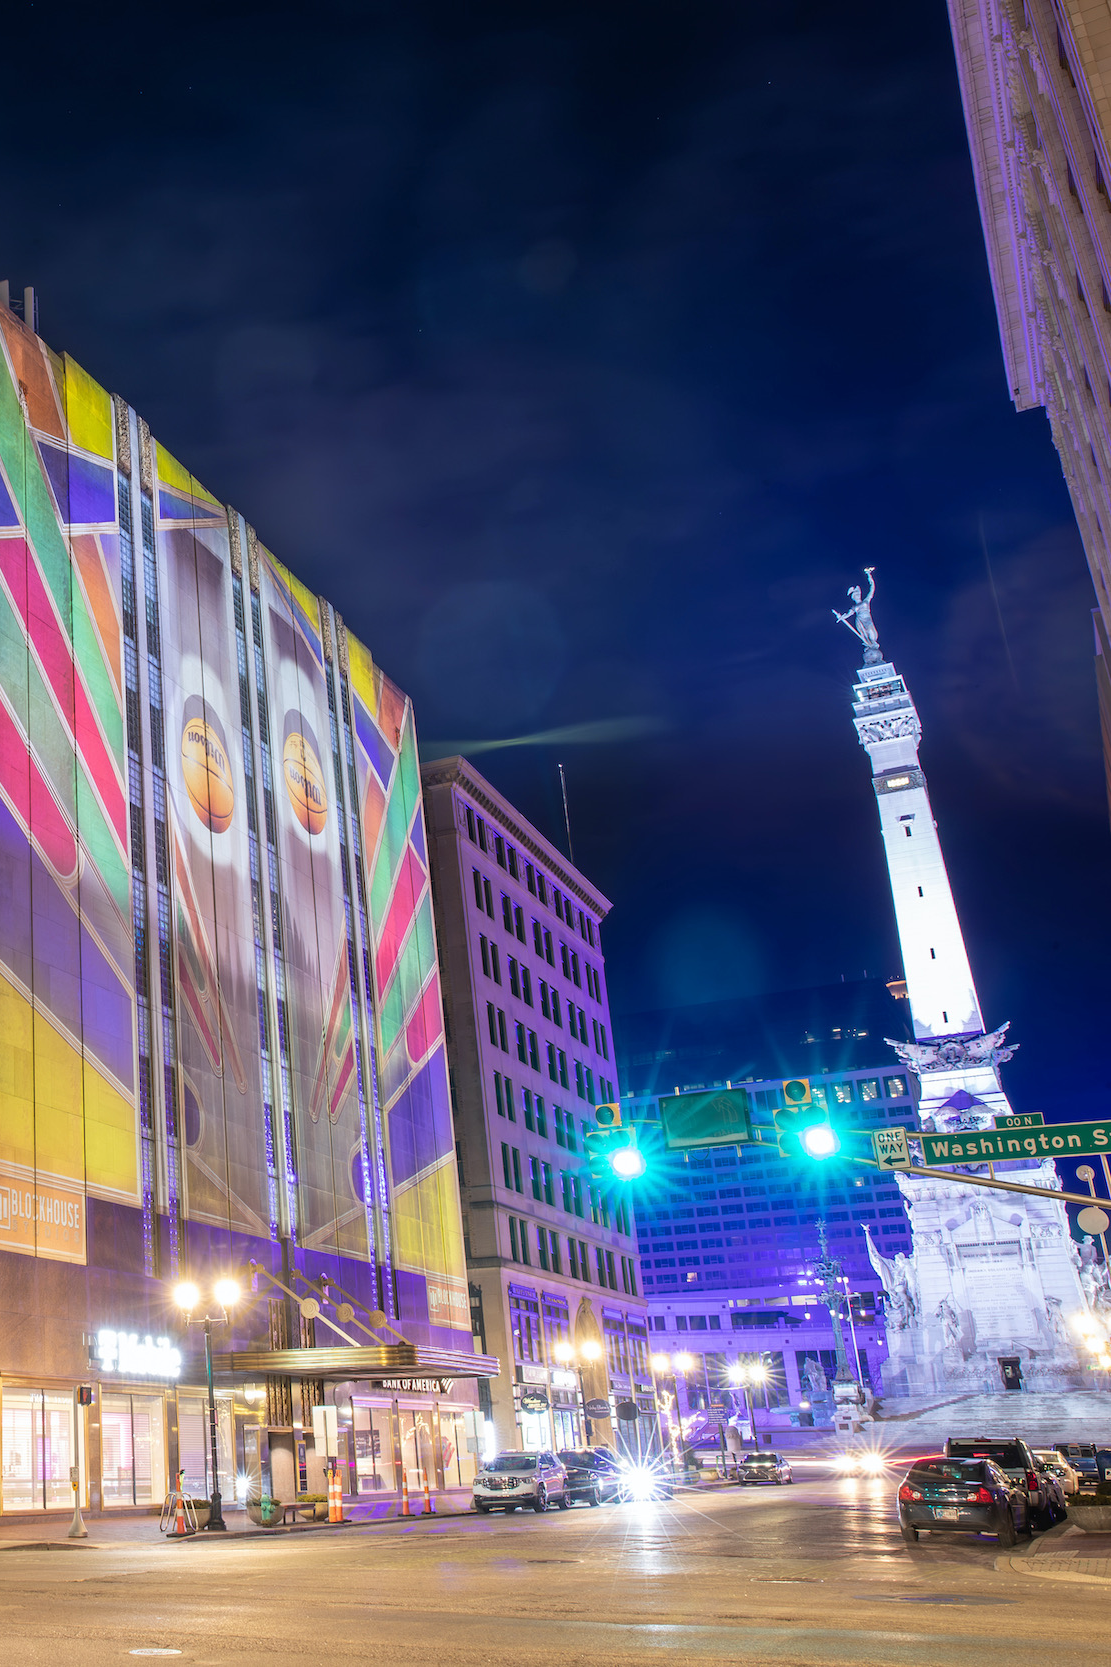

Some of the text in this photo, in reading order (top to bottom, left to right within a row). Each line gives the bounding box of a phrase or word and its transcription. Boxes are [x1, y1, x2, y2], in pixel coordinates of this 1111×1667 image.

[1006, 1116, 1033, 1127] 00 N
[877, 1131, 902, 1143] ONE
[931, 1128, 1111, 1156] Washington S
[879, 1143, 904, 1155] WAY
[11, 1189, 80, 1229] BLOCKHOUSE
[12, 1219, 80, 1244] STUDIOS
[382, 1379, 441, 1393] BANK OF AMERICA
